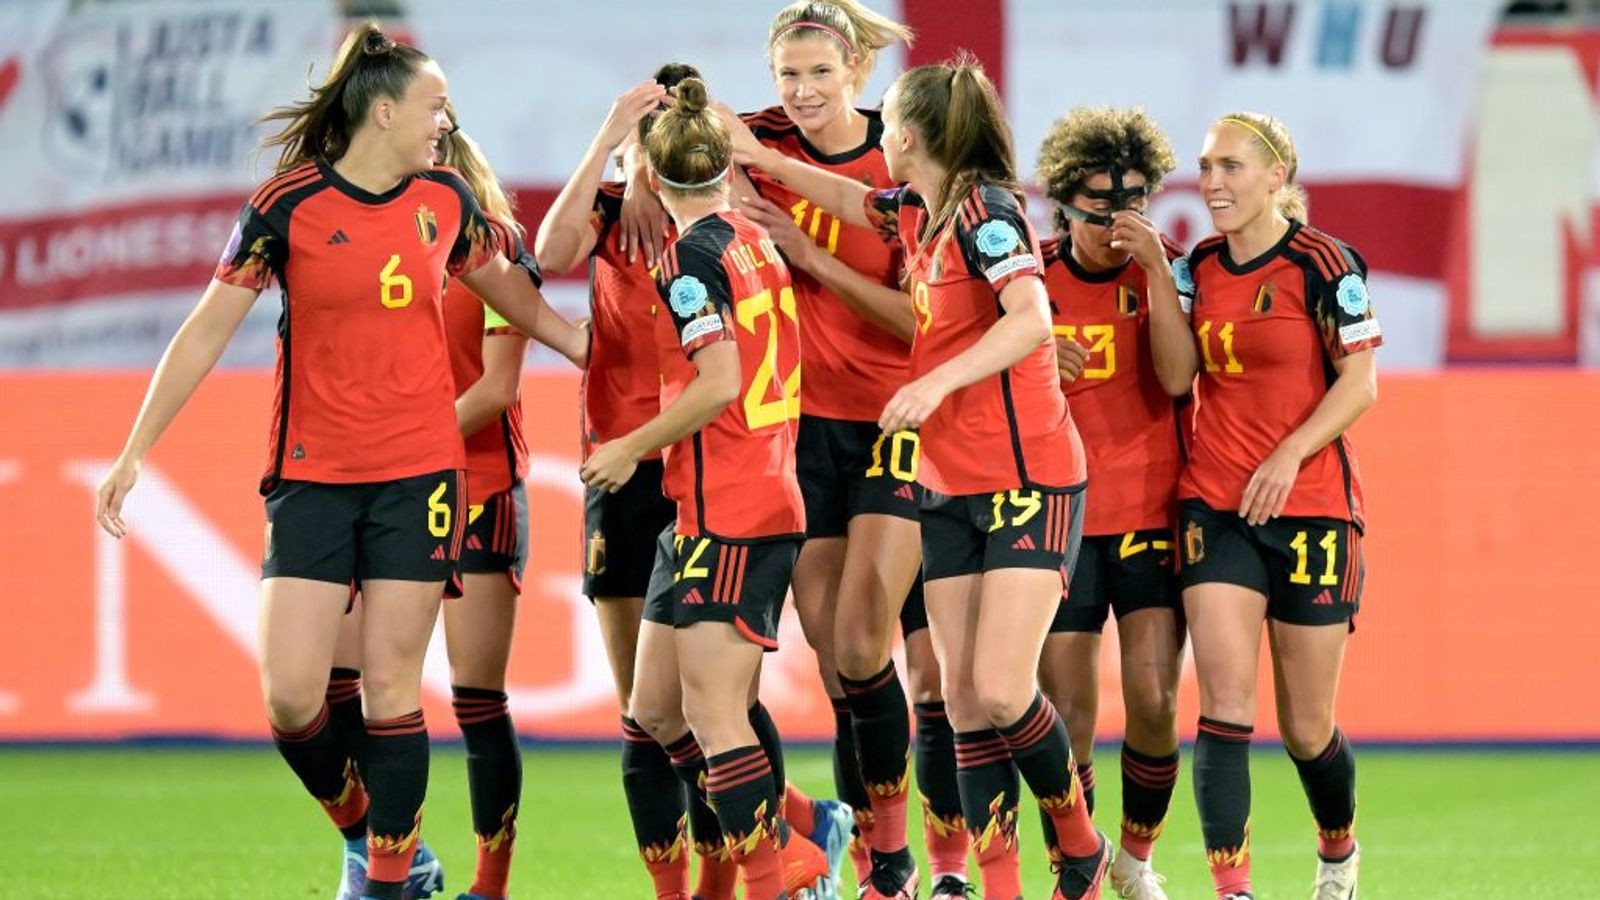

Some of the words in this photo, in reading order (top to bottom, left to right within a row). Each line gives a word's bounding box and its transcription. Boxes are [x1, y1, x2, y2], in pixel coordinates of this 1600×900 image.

[379, 254, 413, 309] 6
[1198, 319, 1244, 374] 11
[865, 430, 920, 482] 10
[428, 482, 451, 538] 6
[1288, 529, 1339, 586] 11
